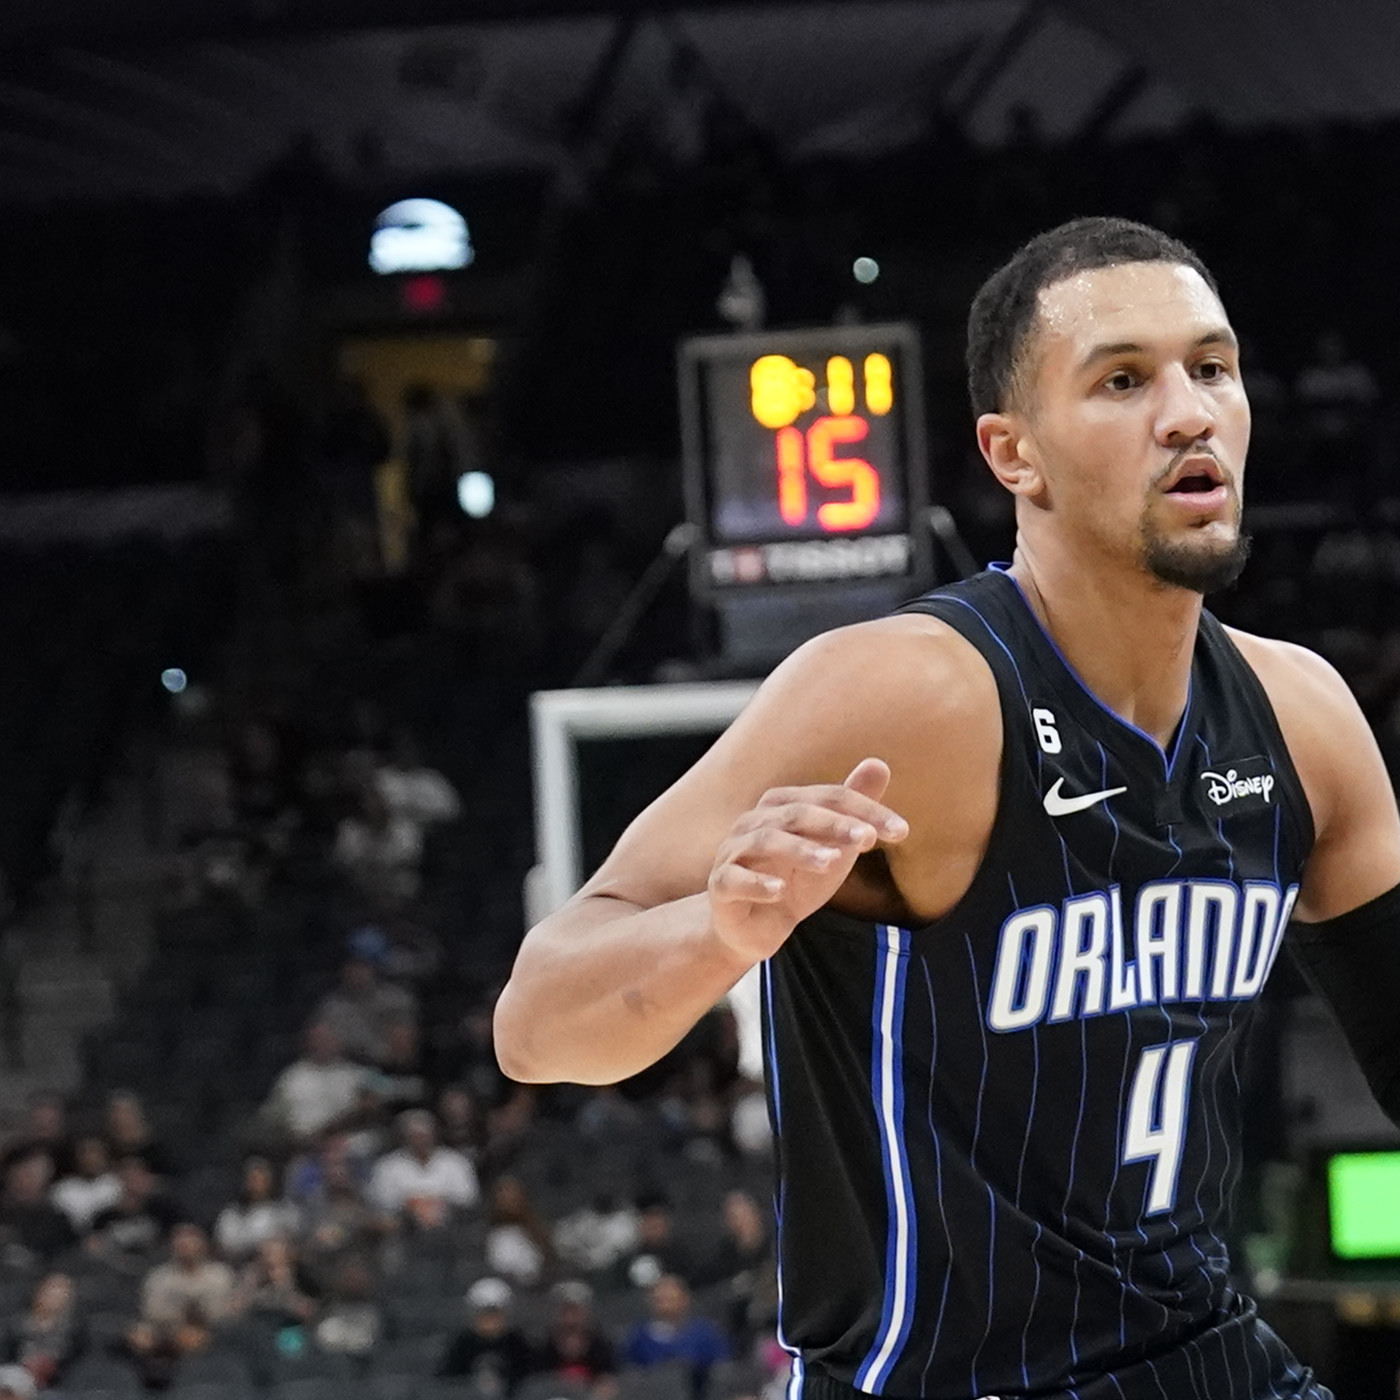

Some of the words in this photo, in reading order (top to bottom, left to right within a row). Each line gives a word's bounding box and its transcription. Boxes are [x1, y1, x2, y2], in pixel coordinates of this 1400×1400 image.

[776, 415, 880, 532] 15
[1032, 708, 1062, 754] 6
[1121, 1037, 1199, 1217] 4
